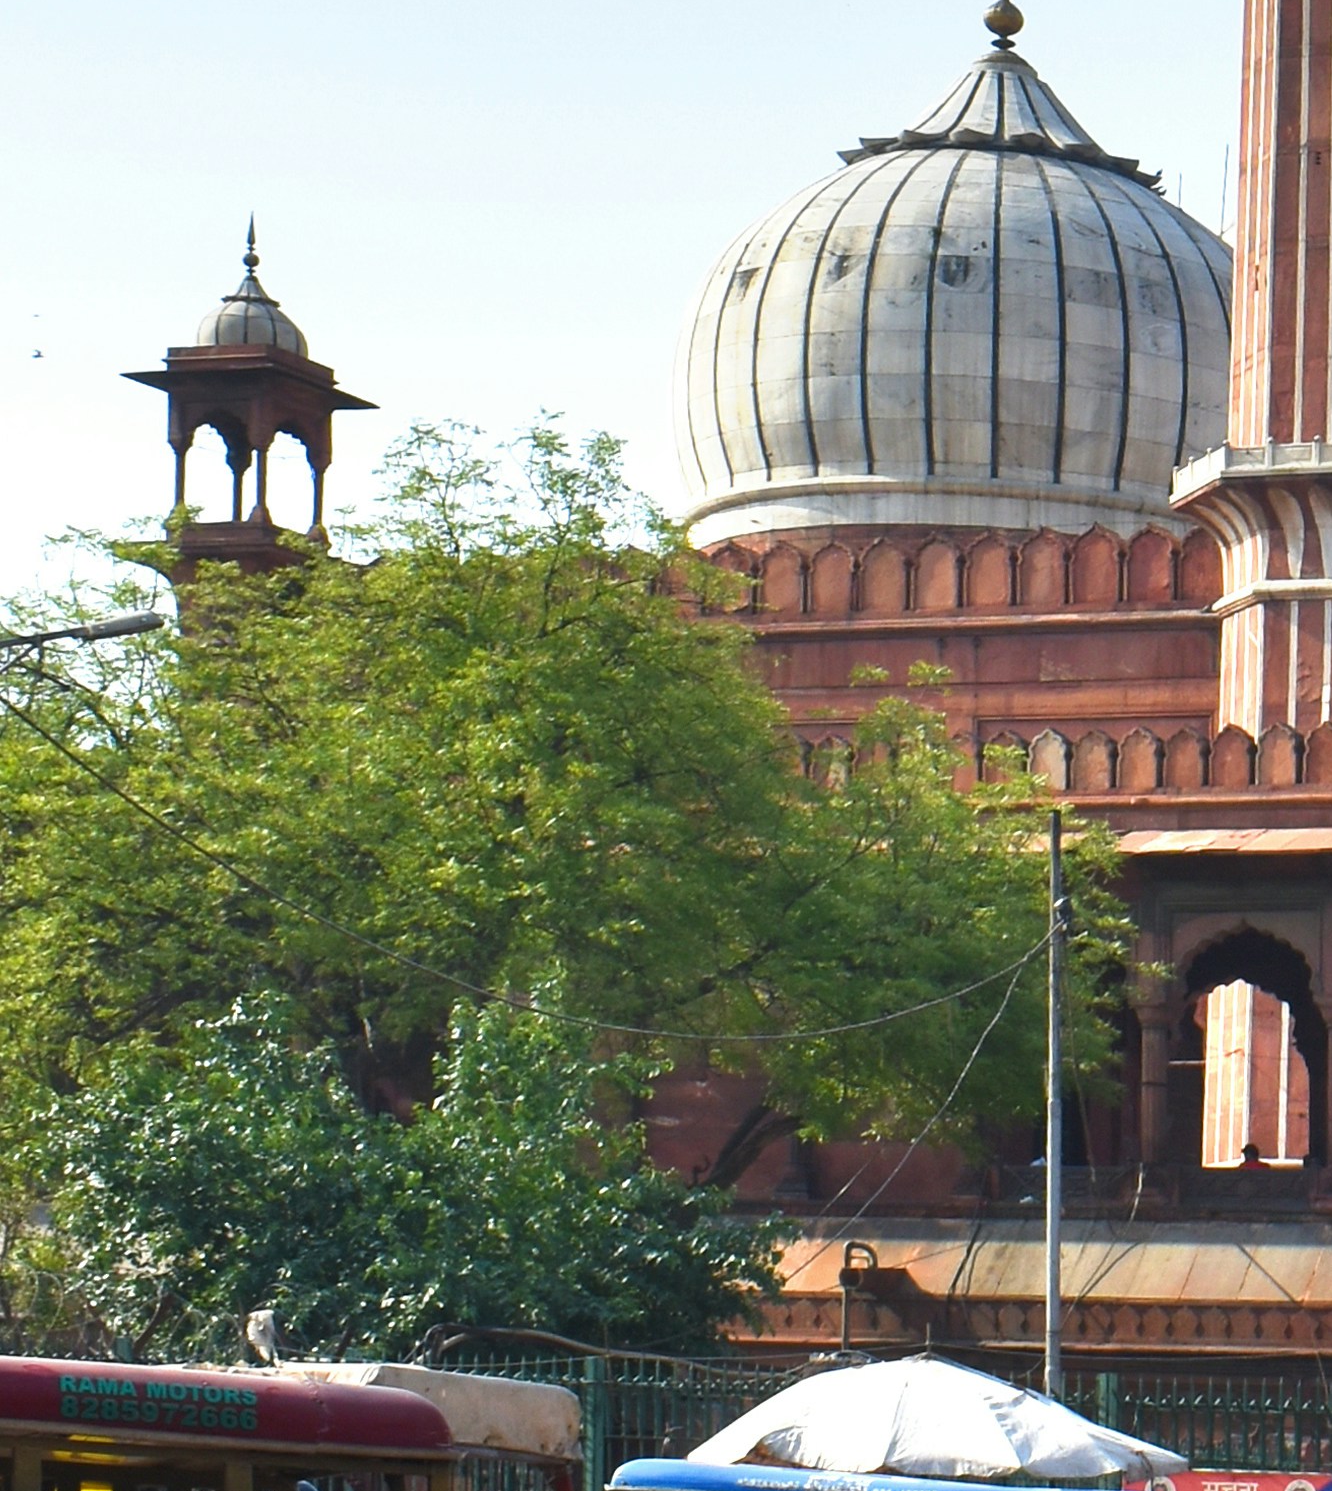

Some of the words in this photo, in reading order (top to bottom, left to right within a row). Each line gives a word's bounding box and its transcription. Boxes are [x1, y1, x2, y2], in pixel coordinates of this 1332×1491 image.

[59, 1374, 138, 1398] RAMA
[147, 1382, 258, 1406] MOTORS
[60, 1395, 258, 1431] 8285972666
